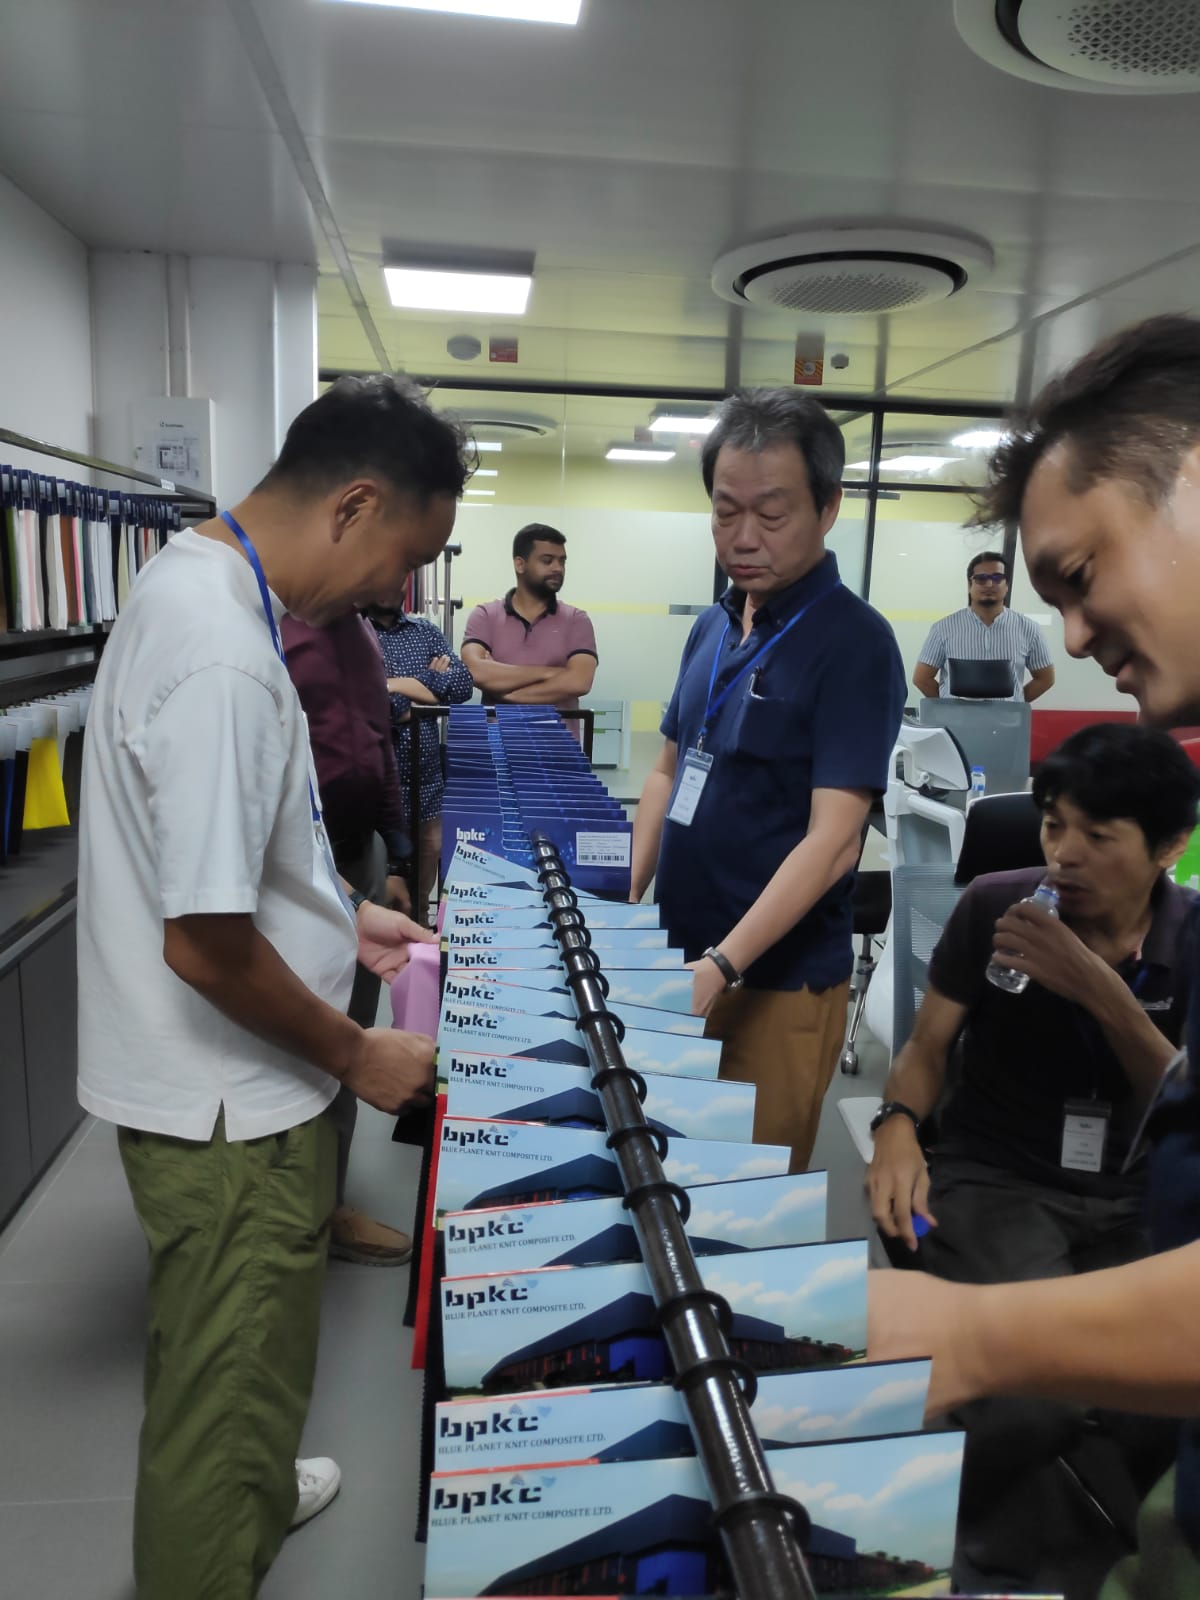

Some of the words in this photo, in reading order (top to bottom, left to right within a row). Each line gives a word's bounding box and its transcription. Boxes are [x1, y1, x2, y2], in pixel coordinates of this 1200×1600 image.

[456, 827, 486, 842] bpkc
[456, 845, 487, 865] bpkc
[450, 885, 487, 898] bpkc
[455, 914, 494, 926] bpkc
[450, 933, 492, 946] bpkc
[454, 953, 497, 967] bpkc
[445, 981, 495, 1000] bpkc
[445, 1010, 498, 1029] bpkc
[451, 1058, 507, 1077] bpkc
[464, 1078, 485, 1086] PLANET
[443, 1126, 509, 1146] bpkc
[459, 1147, 484, 1155] PLANET
[502, 1152, 538, 1161] COMPOSITE
[449, 1220, 524, 1244] bpkc
[469, 1243, 496, 1252] PLANET
[499, 1240, 518, 1248] KNIT
[518, 1236, 559, 1246] COMPOSITE
[445, 1285, 528, 1309] bpkc
[445, 1311, 466, 1320] BLUE
[468, 1308, 498, 1318] PLANET
[500, 1307, 520, 1316] KNIT
[522, 1304, 567, 1314] COMPOSITE
[440, 1413, 539, 1442] bpkc
[438, 1445, 462, 1454] BLUE
[465, 1442, 502, 1452] PLANET
[504, 1440, 528, 1449] KNIT
[530, 1436, 585, 1448] COMPOSITE
[434, 1483, 542, 1514] bpkc
[431, 1517, 458, 1528] BLUE
[460, 1514, 501, 1526] PLANET
[504, 1512, 528, 1522] KNIT
[532, 1508, 591, 1520] COMPOSITE
